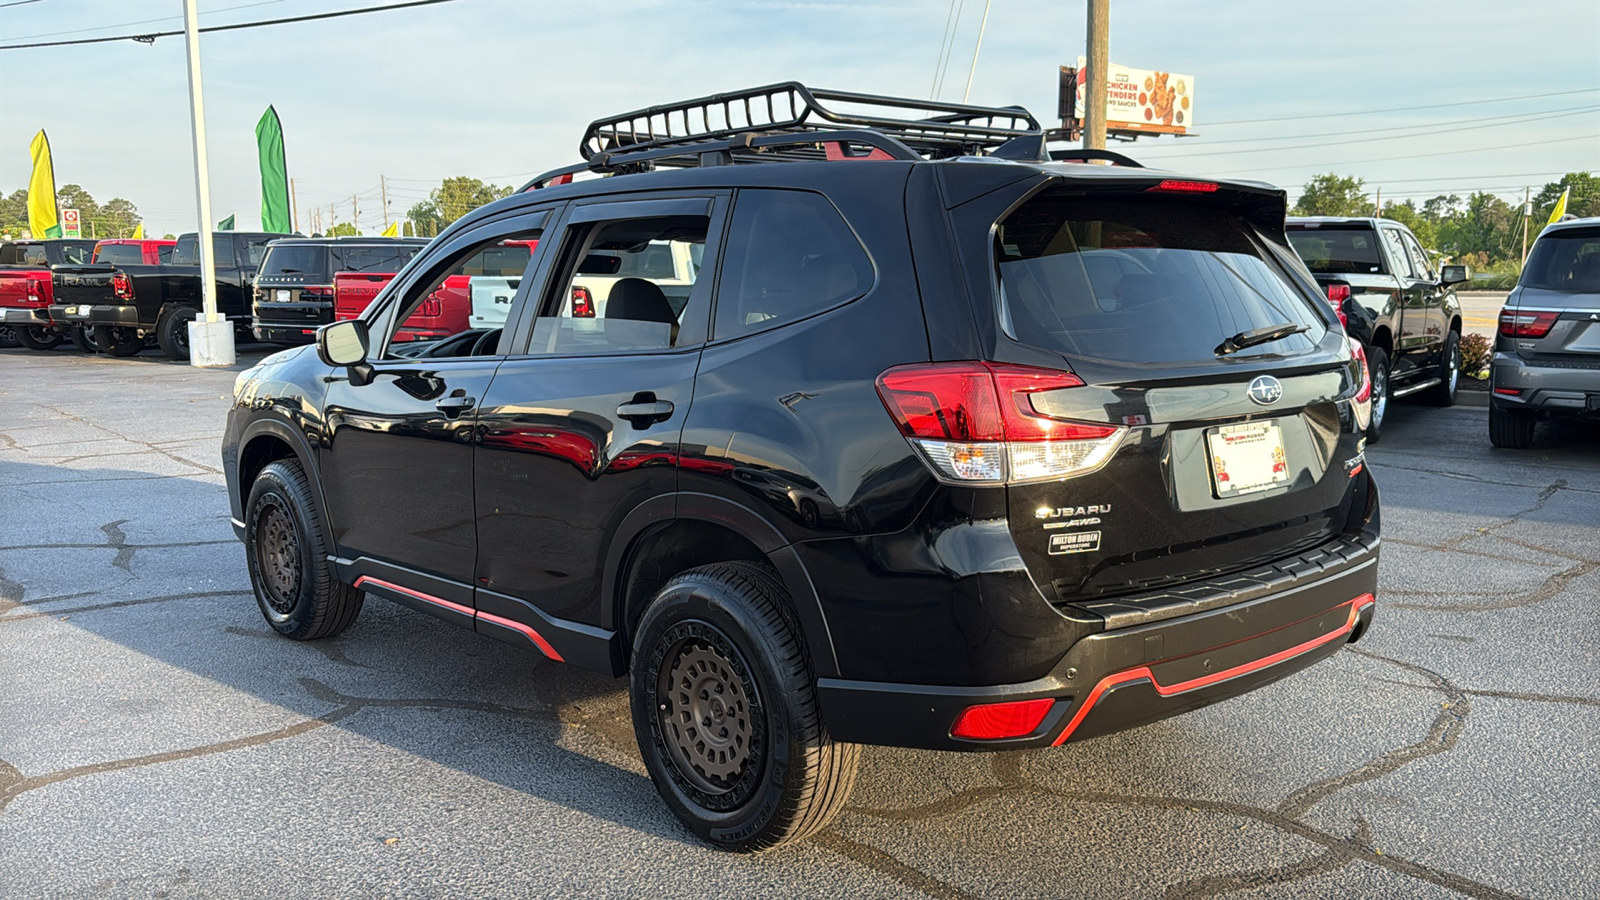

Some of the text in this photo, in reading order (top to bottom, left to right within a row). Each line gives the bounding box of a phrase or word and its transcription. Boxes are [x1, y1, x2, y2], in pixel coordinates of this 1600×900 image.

[1106, 81, 1137, 91] CHICKEN
[1106, 91, 1137, 100] TENDERS
[63, 278, 98, 286] RAM
[340, 287, 382, 295] CHEVR
[1035, 504, 1111, 519] SUBARU
[1066, 517, 1101, 527] AWD
[1053, 534, 1098, 545] MILTON RUBEN
[719, 801, 773, 842] RELIATREK
